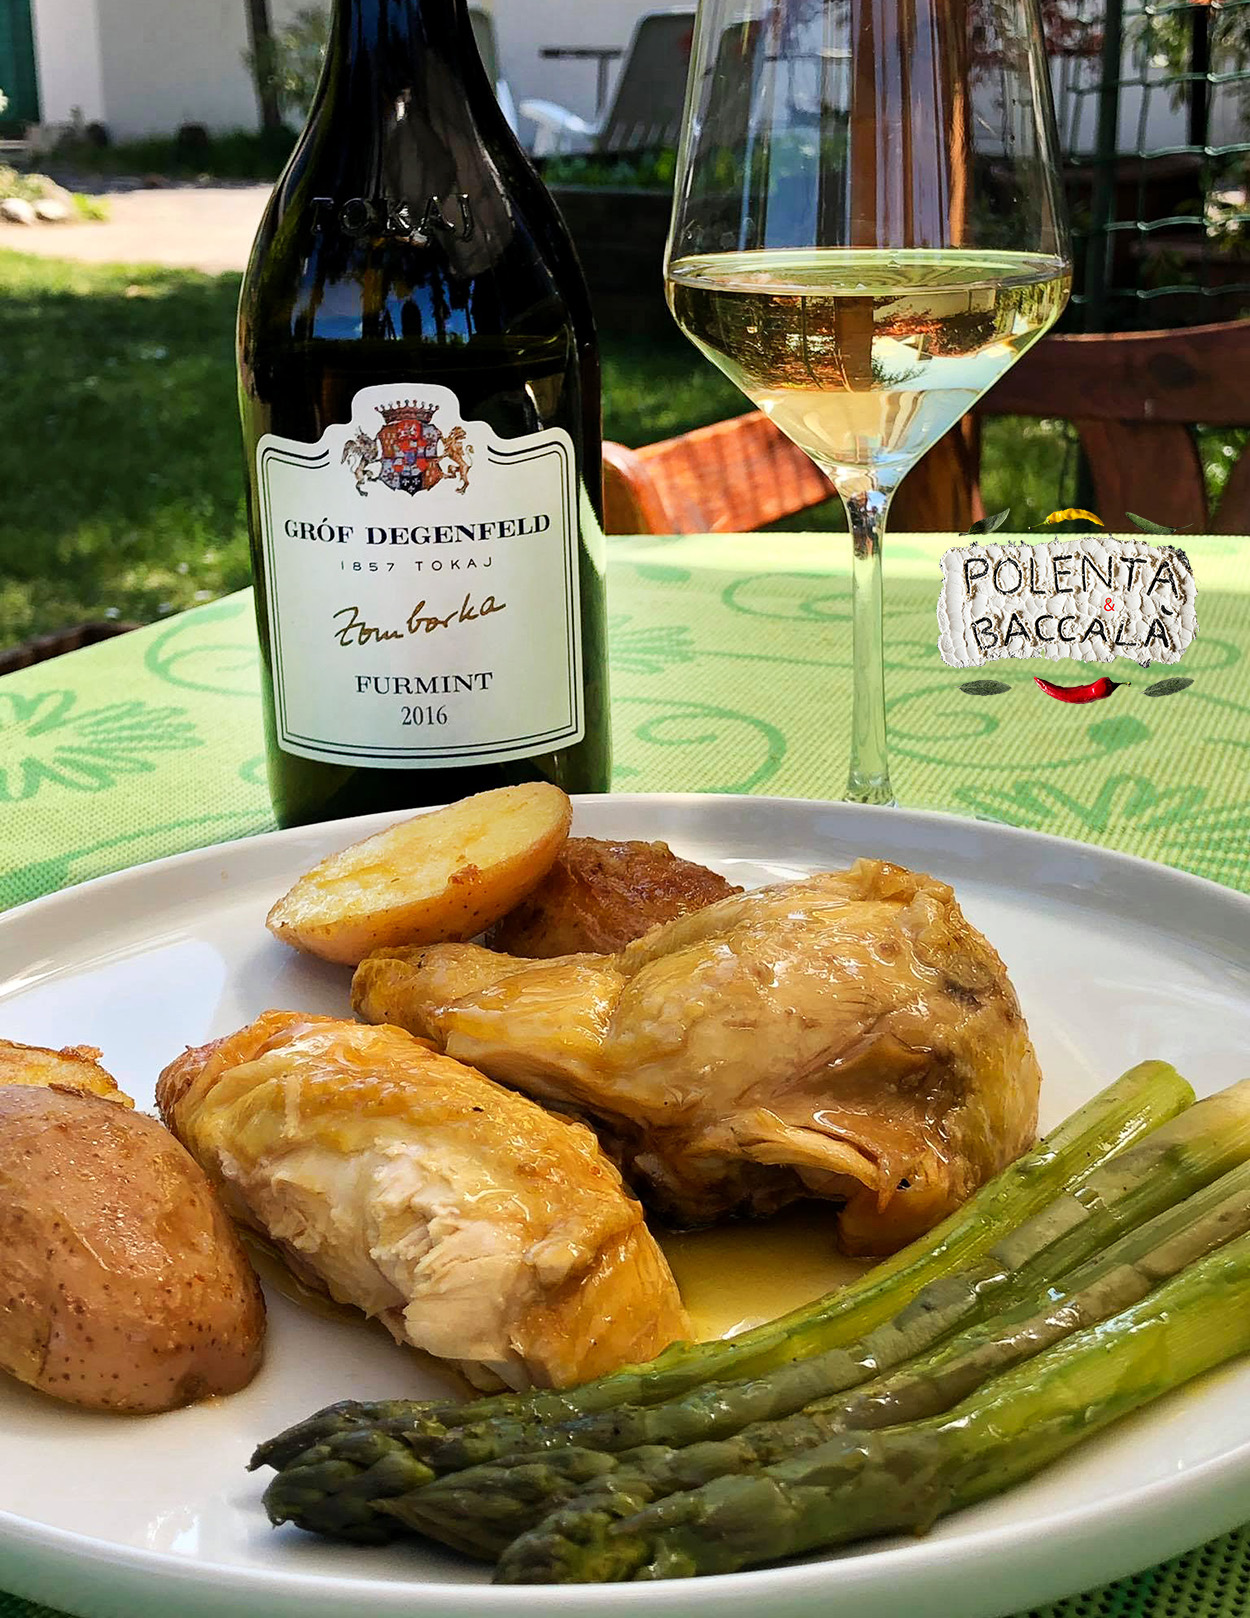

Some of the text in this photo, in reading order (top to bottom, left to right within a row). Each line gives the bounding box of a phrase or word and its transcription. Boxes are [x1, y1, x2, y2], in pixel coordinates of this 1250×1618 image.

[310, 193, 474, 242] TOKAJ
[284, 513, 551, 546] GRÓF DEGENFELD
[340, 556, 493, 573] 1857 TOKAJ
[354, 671, 493, 695] FURMINT
[400, 704, 448, 727] 2016
